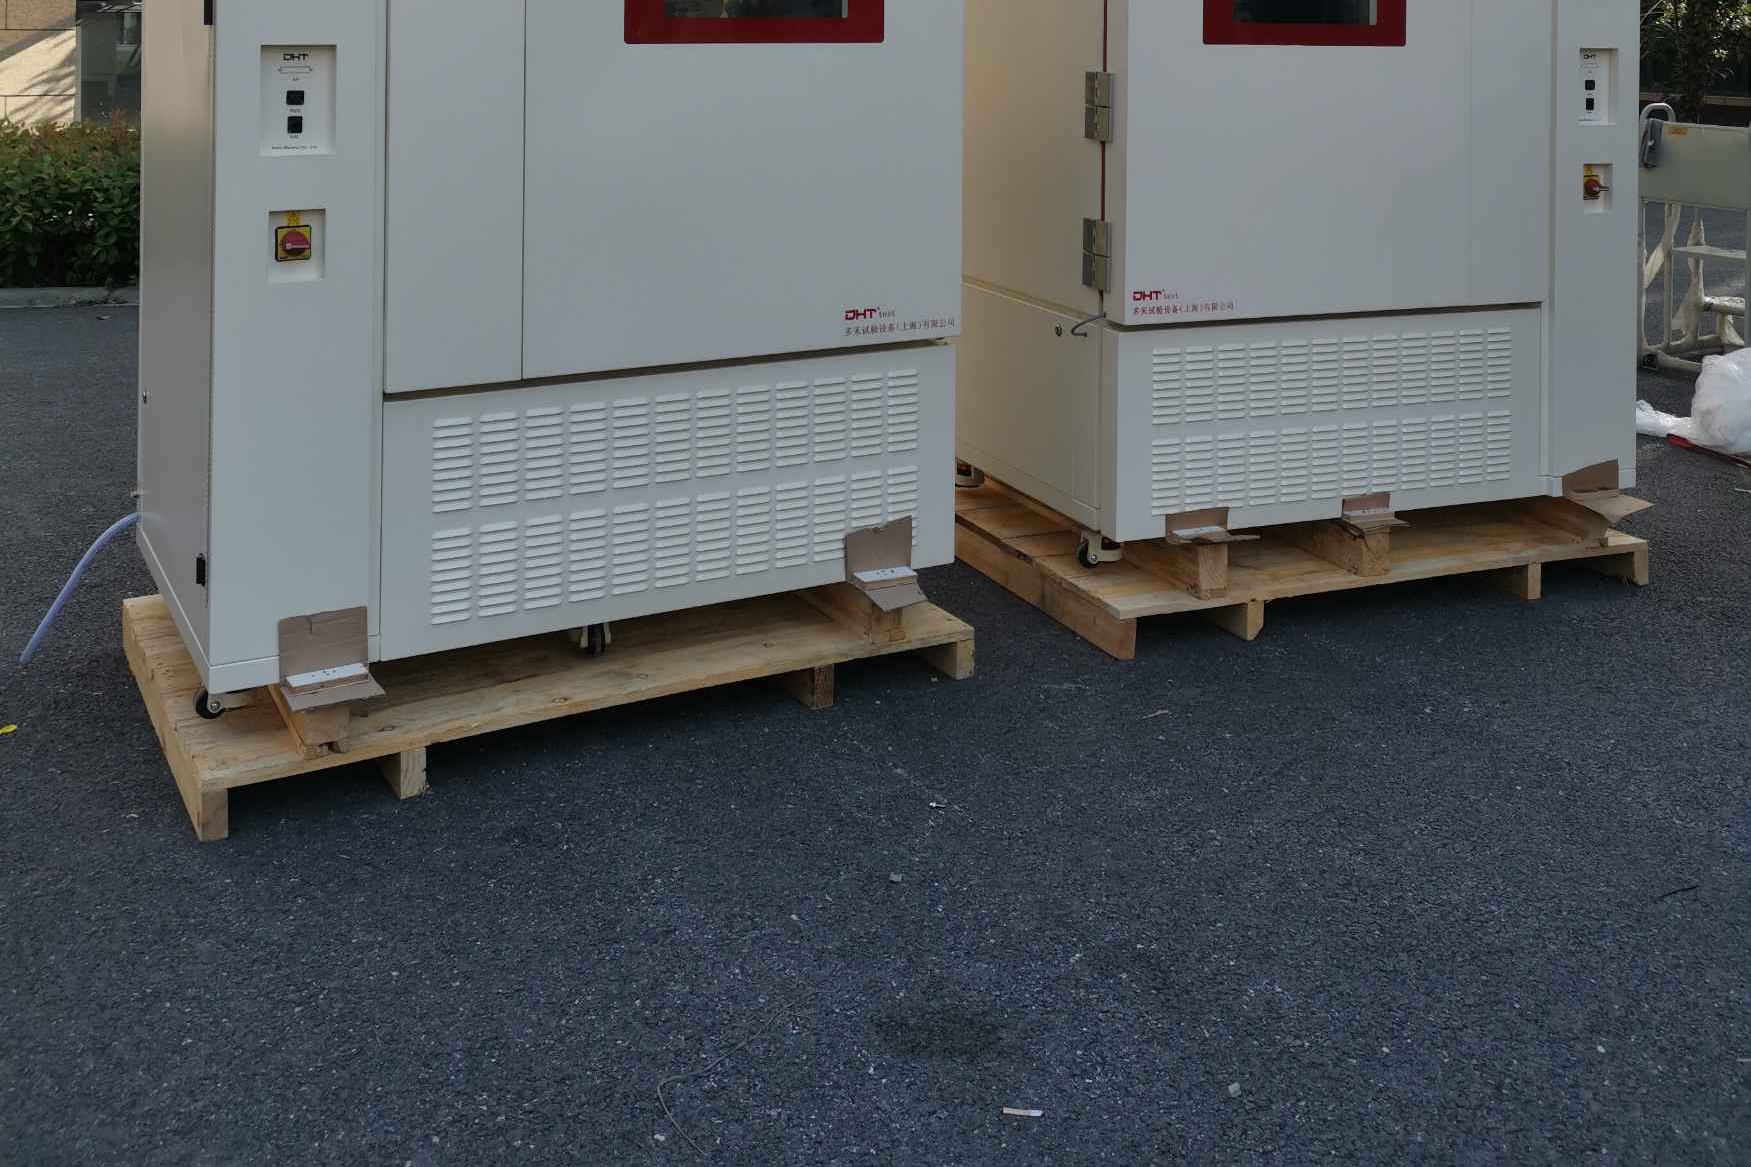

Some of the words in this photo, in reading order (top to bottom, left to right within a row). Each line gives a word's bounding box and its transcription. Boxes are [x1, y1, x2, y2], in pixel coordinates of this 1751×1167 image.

[283, 52, 310, 62] DHT
[1132, 290, 1163, 302] DHT
[844, 307, 879, 321] DHT
